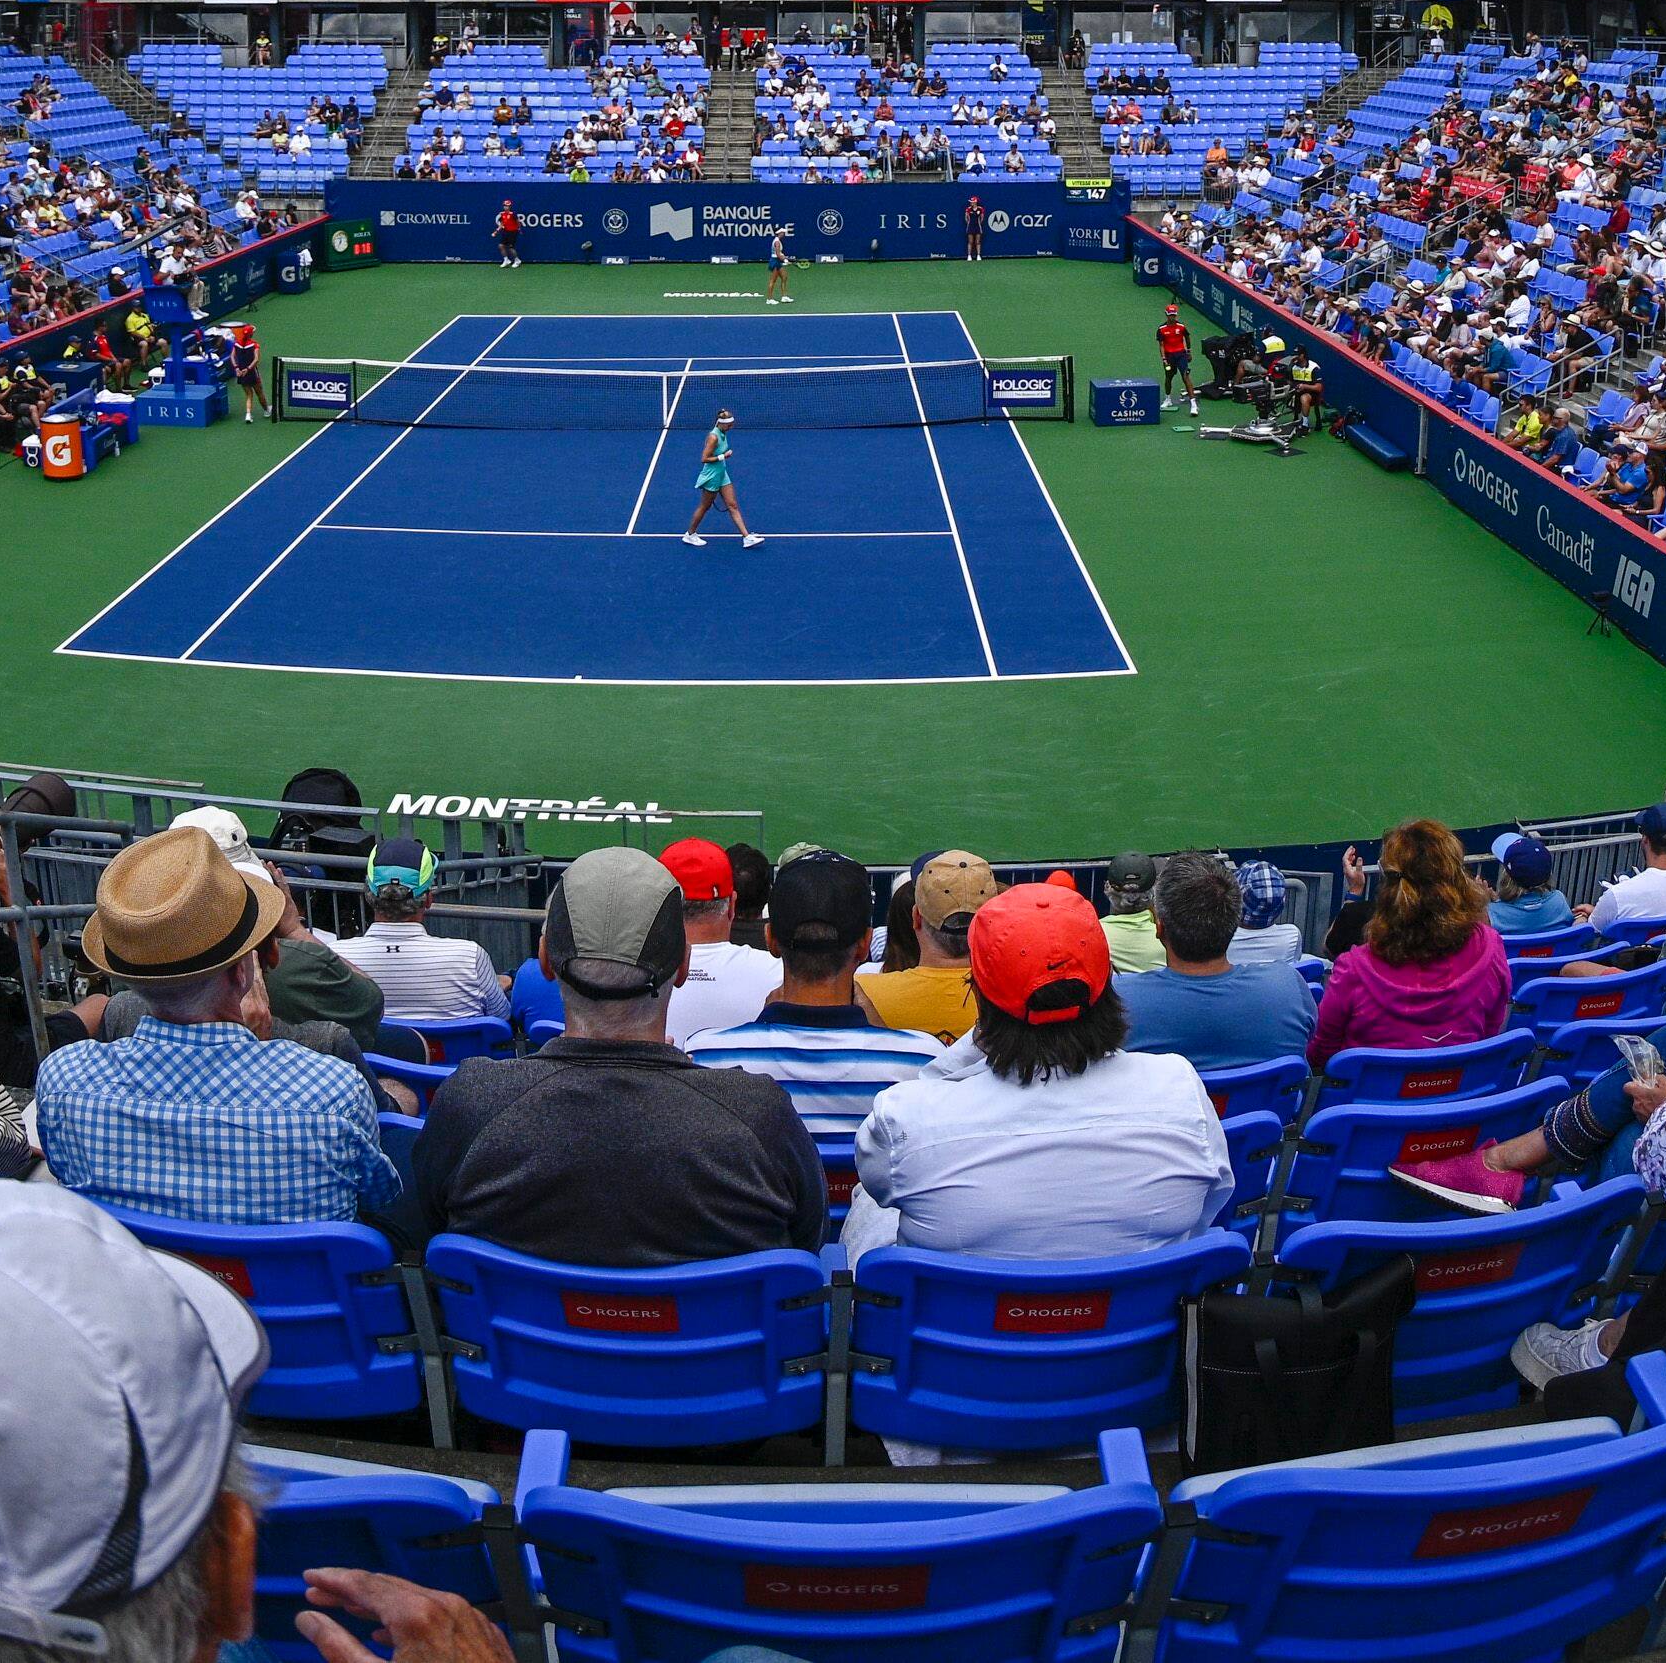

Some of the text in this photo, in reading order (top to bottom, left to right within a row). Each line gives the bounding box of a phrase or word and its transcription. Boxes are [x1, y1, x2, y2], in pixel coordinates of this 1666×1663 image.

[1086, 188, 1106, 199] 147
[396, 214, 471, 225] CROMWELL
[703, 205, 771, 220] BANQUE
[1014, 213, 1052, 227] razr
[879, 214, 948, 229] IRIS
[703, 223, 795, 237] NATIONAE
[1069, 228, 1101, 239] YORK
[1144, 257, 1159, 274] G
[281, 266, 295, 282] G
[292, 379, 347, 394] HOLOGIC
[993, 379, 1052, 391] HOLOGIC
[147, 406, 195, 419] IRIS
[46, 434, 72, 467] G
[1467, 458, 1519, 517] ROGERS
[1536, 504, 1595, 576] Canada
[1612, 553, 1656, 619] IGA
[386, 793, 673, 824] MONTRÉAL
[1588, 1000, 1616, 1009] ROGERS
[1417, 1077, 1453, 1088] ROGERS
[1422, 1139, 1466, 1151] ROGERS
[1443, 1258, 1505, 1276] ROGERS
[596, 1307, 661, 1318] ROGERS
[1028, 1305, 1093, 1317] ROGERS
[1469, 1508, 1562, 1538] ROGERS
[797, 1581, 900, 1596] ROGERS
